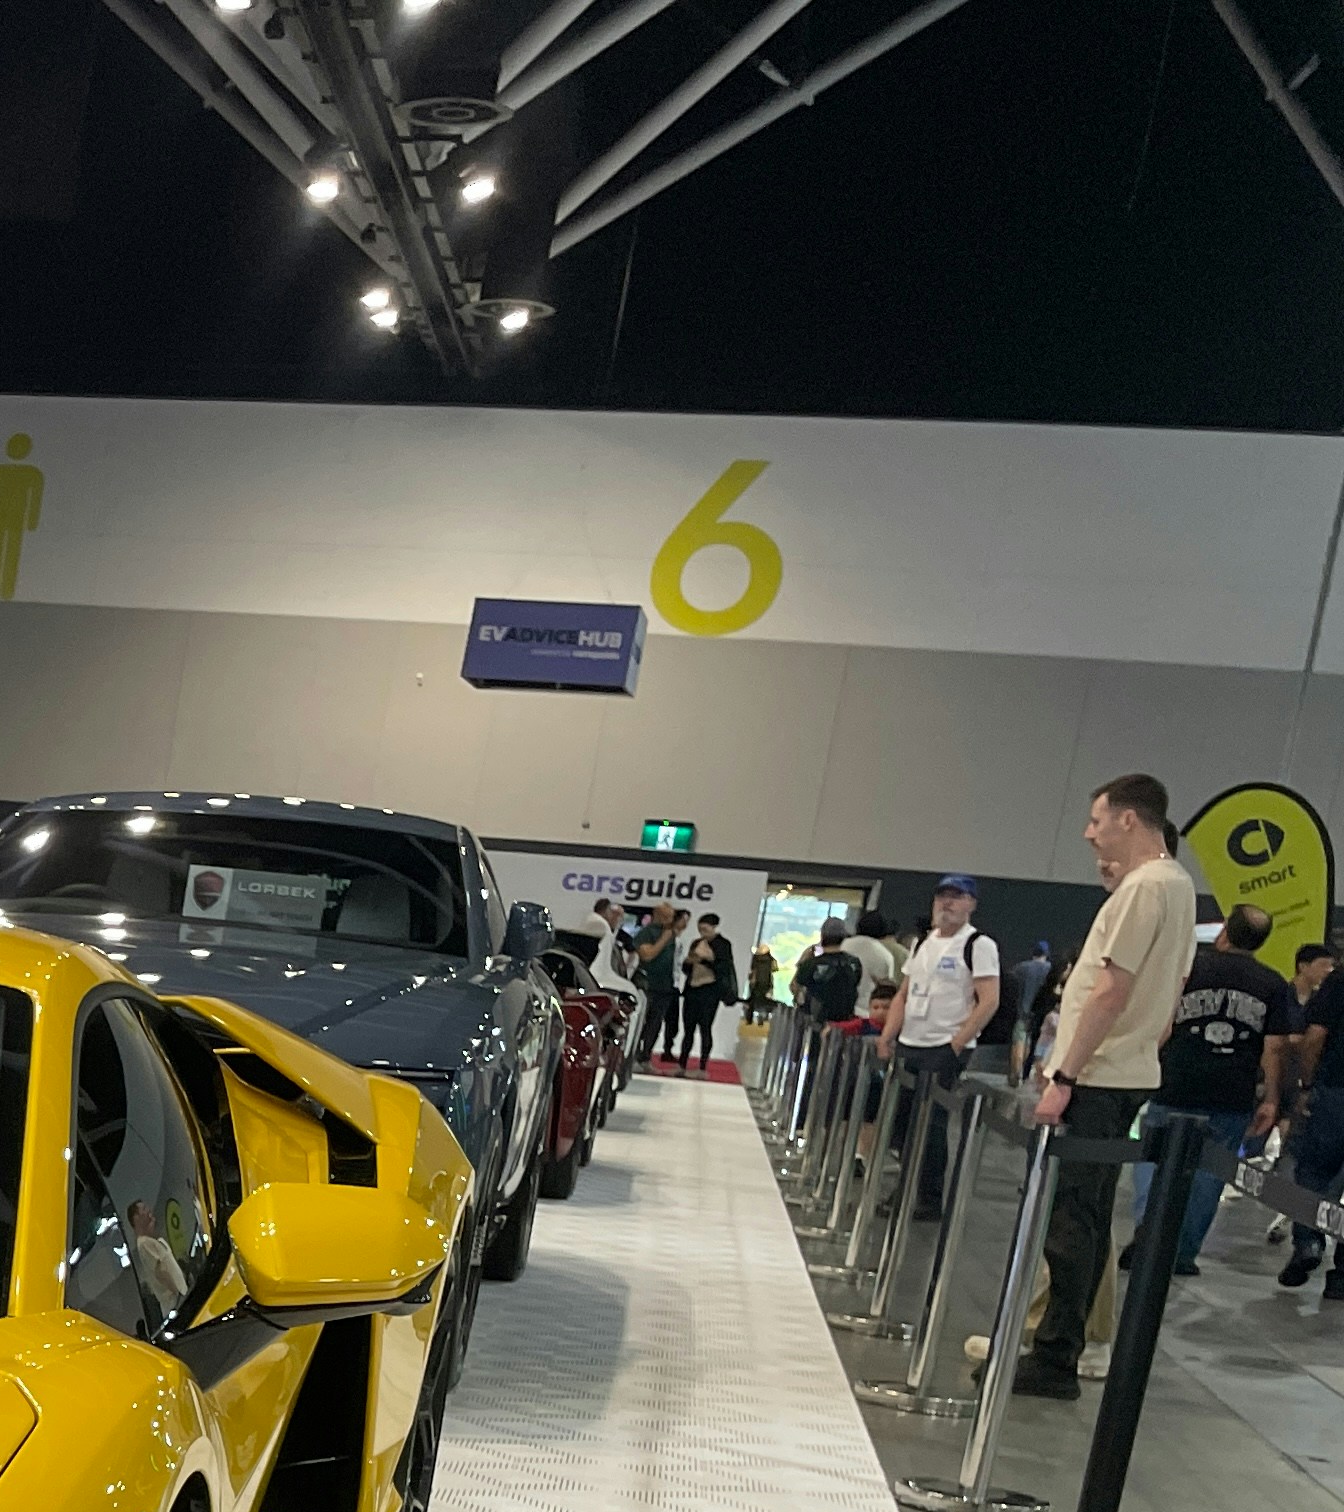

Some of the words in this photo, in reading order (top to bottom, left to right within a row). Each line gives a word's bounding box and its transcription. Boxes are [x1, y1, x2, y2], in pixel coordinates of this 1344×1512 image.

[650, 459, 783, 637] 6
[238, 881, 316, 899] LORBEK
[562, 872, 714, 901] carsguide
[1239, 864, 1297, 895] smart
